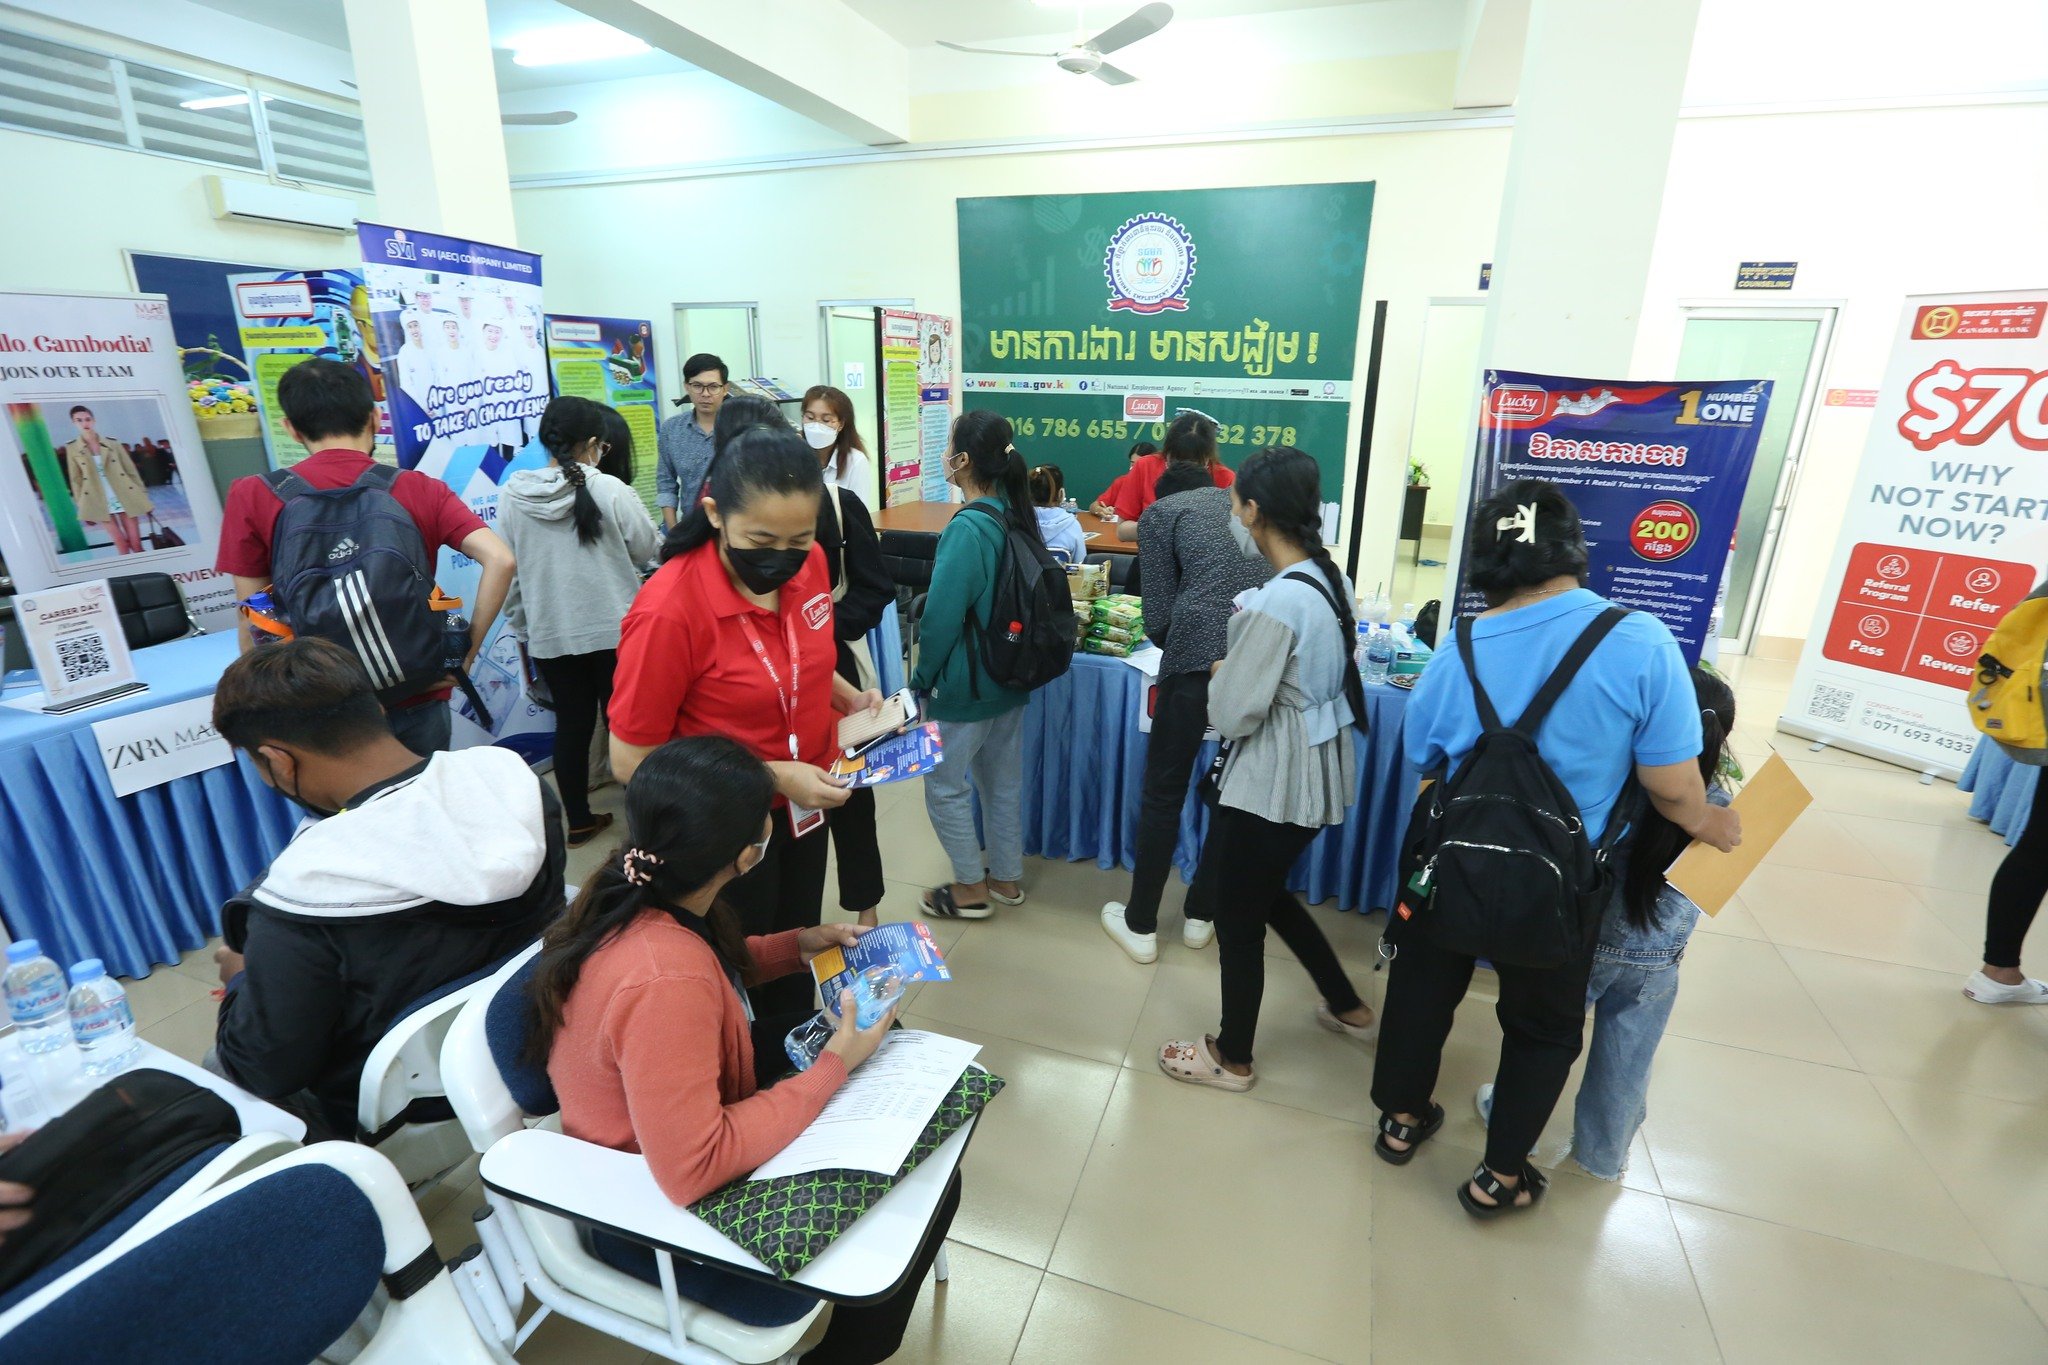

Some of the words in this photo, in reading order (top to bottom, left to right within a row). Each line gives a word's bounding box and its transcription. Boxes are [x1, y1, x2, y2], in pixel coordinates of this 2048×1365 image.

[421, 248, 437, 259] SVI
[437, 249, 460, 263] (AEC)
[461, 253, 502, 269] COMPANY
[502, 260, 533, 274] LIMITED
[1132, 289, 1170, 301] EMPLOYMENT
[1170, 268, 1184, 289] AGENCY
[1738, 280, 1791, 288] COUNSELING
[2002, 326, 2030, 334] BANK
[33, 334, 154, 353] Cambodia!
[0, 365, 40, 381] JOIN
[43, 365, 79, 379] OUR
[83, 365, 135, 378] TEAM
[846, 373, 863, 387] SVI
[427, 385, 456, 410] Are
[457, 379, 484, 405] you
[484, 370, 533, 396] ready
[1106, 383, 1130, 391] National
[1131, 383, 1164, 392] Employment
[1167, 384, 1187, 393] Agency
[1130, 399, 1159, 414] Lucky
[1497, 392, 1538, 412] Lucky
[1675, 390, 1702, 425] 1
[1705, 393, 1759, 404] NUMBER
[412, 421, 433, 442] TO
[432, 410, 465, 439] TAKE
[466, 408, 478, 430] A
[478, 394, 550, 426] CHALLENG
[1701, 403, 1756, 422] ONE
[1041, 418, 1081, 437] 786
[1086, 419, 1128, 440] 655
[1216, 424, 1245, 445] 32
[1251, 425, 1297, 447] 378
[1550, 476, 1584, 485] Number
[1591, 479, 1616, 488] Retail
[1618, 480, 1641, 489] Team
[1642, 482, 1651, 490] in
[1931, 461, 2014, 486] WHY
[471, 496, 484, 506] WE
[1870, 484, 1944, 508] NOT
[1951, 491, 2048, 521] START
[473, 506, 497, 521] HIR
[1636, 520, 1690, 541] 200
[1898, 514, 2006, 544] NOW?
[1859, 587, 1909, 602] Program
[1863, 578, 1911, 593] Referral
[187, 588, 235, 604] opportun
[1640, 589, 1670, 599] Assistant
[1669, 592, 1705, 603] Supervisor
[1949, 594, 2001, 614] Refer
[40, 607, 79, 621] CAREER
[80, 602, 100, 614] DAY
[205, 601, 242, 616] fashio
[1664, 612, 1693, 623] Analyst
[1849, 639, 1885, 657] Pass
[1918, 653, 1976, 677] Rewar
[1873, 719, 1899, 734] 071
[1902, 728, 1931, 743] 693
[1934, 736, 1974, 754] 4333
[108, 737, 170, 769] ZARA
